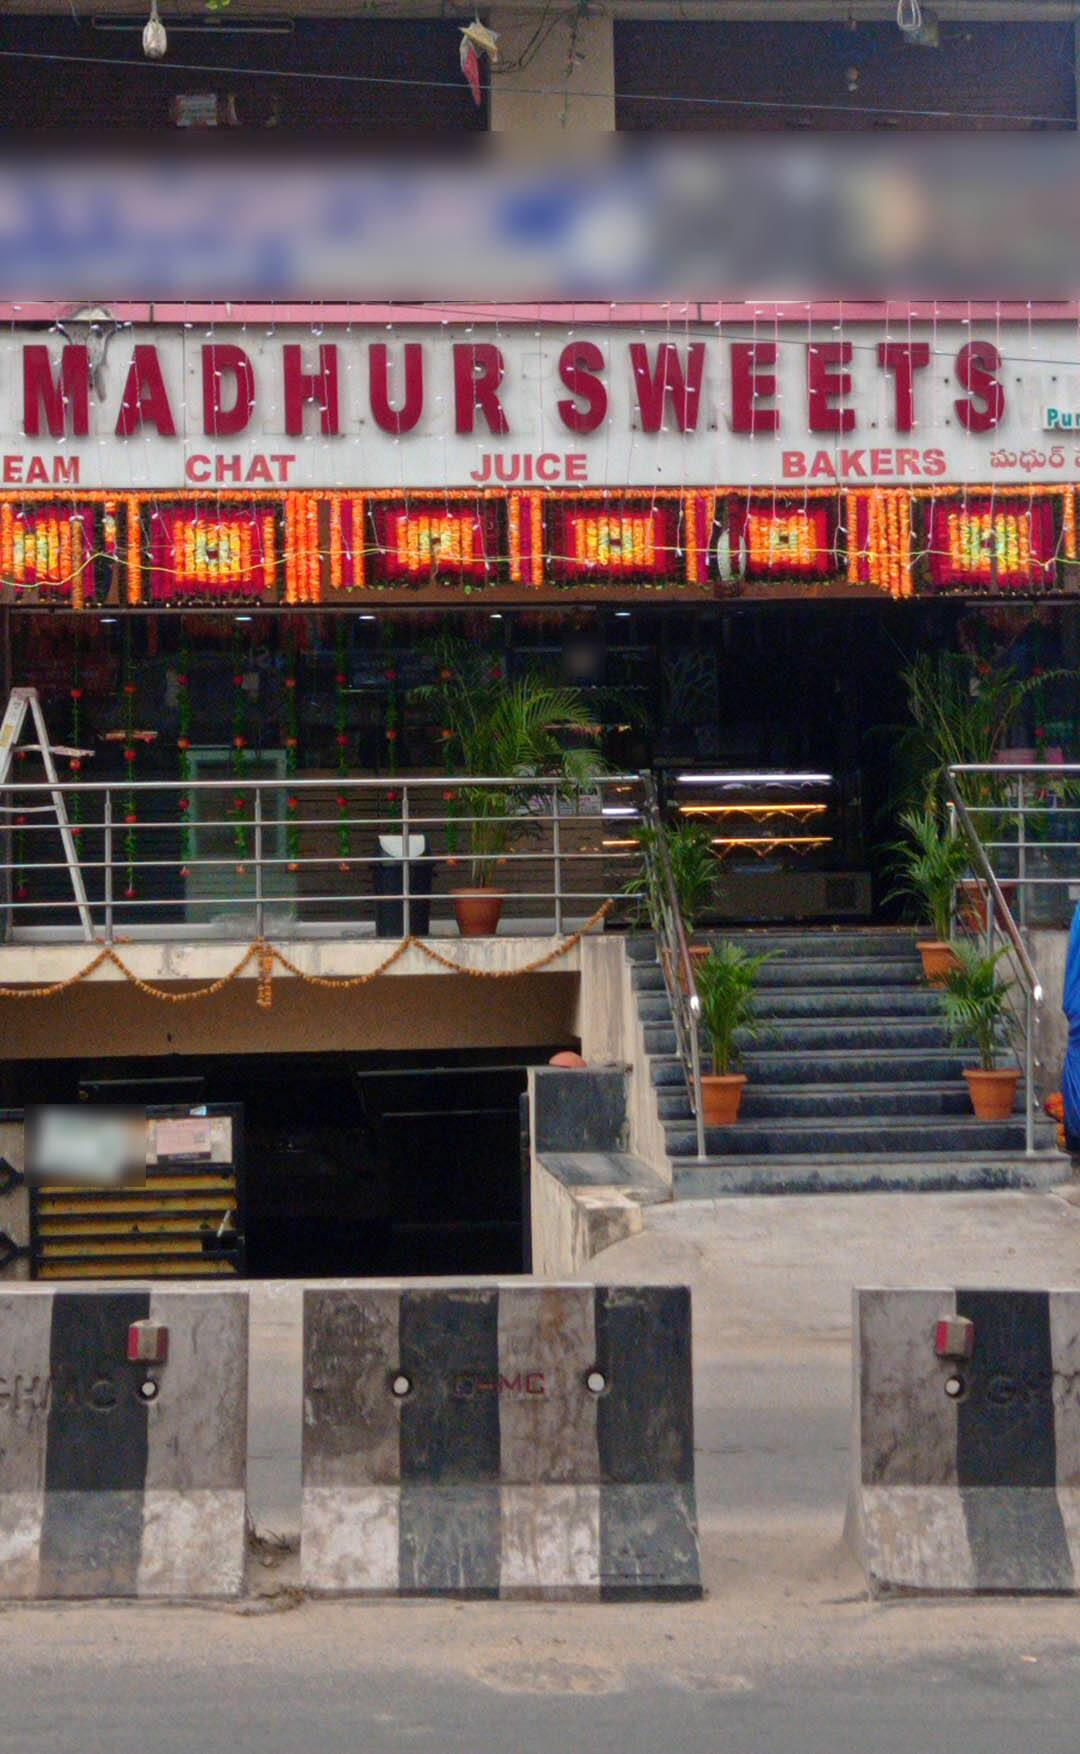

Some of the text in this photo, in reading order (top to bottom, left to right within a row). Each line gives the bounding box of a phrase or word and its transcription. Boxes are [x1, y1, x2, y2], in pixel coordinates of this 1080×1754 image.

[23, 341, 1006, 437] MADHUR SWEETS
[3, 455, 81, 484] EAM
[186, 454, 297, 483] CHAT
[471, 453, 588, 483] JUICE
[782, 448, 948, 479] BAKERS
